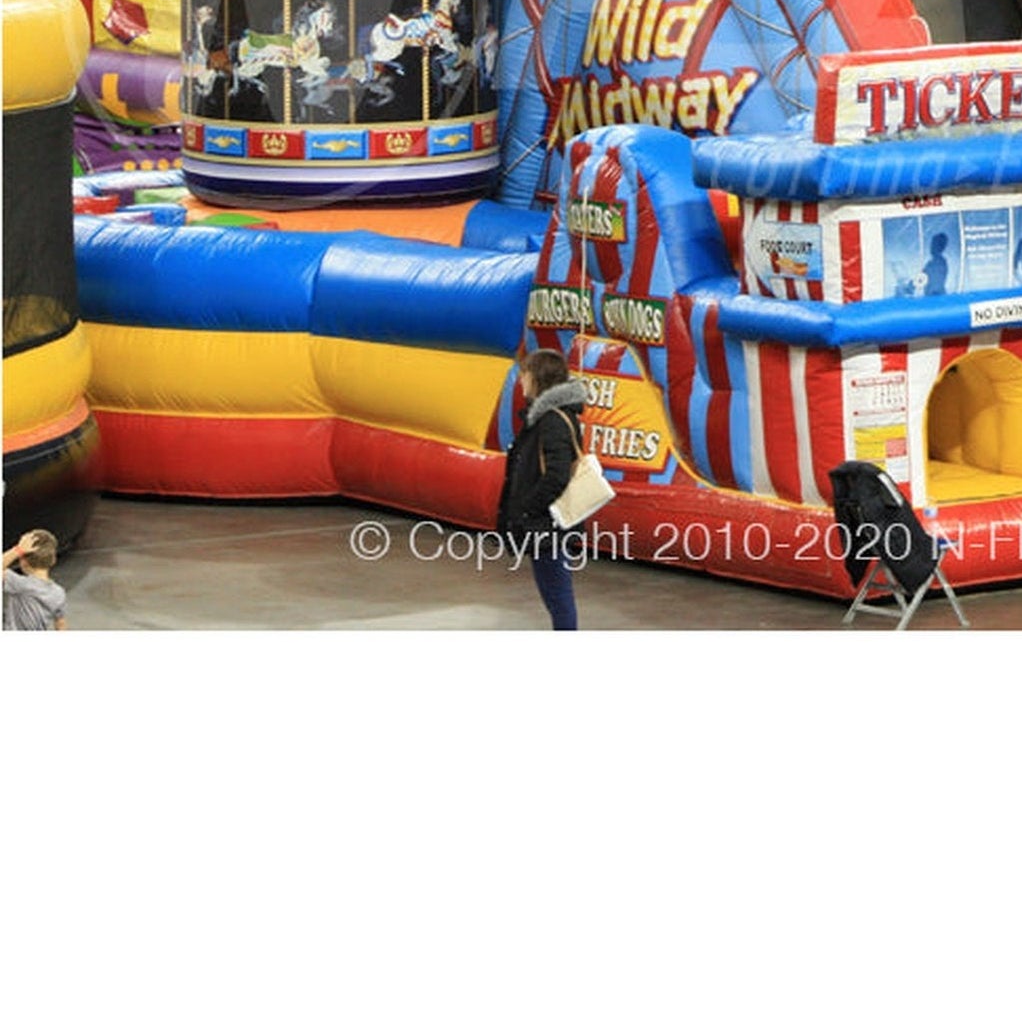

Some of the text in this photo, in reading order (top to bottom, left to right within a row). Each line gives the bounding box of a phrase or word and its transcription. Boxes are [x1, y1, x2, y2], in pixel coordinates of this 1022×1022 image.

[547, 68, 759, 151] Midway
[974, 307, 993, 321] NO
[588, 424, 661, 460] FRIES
